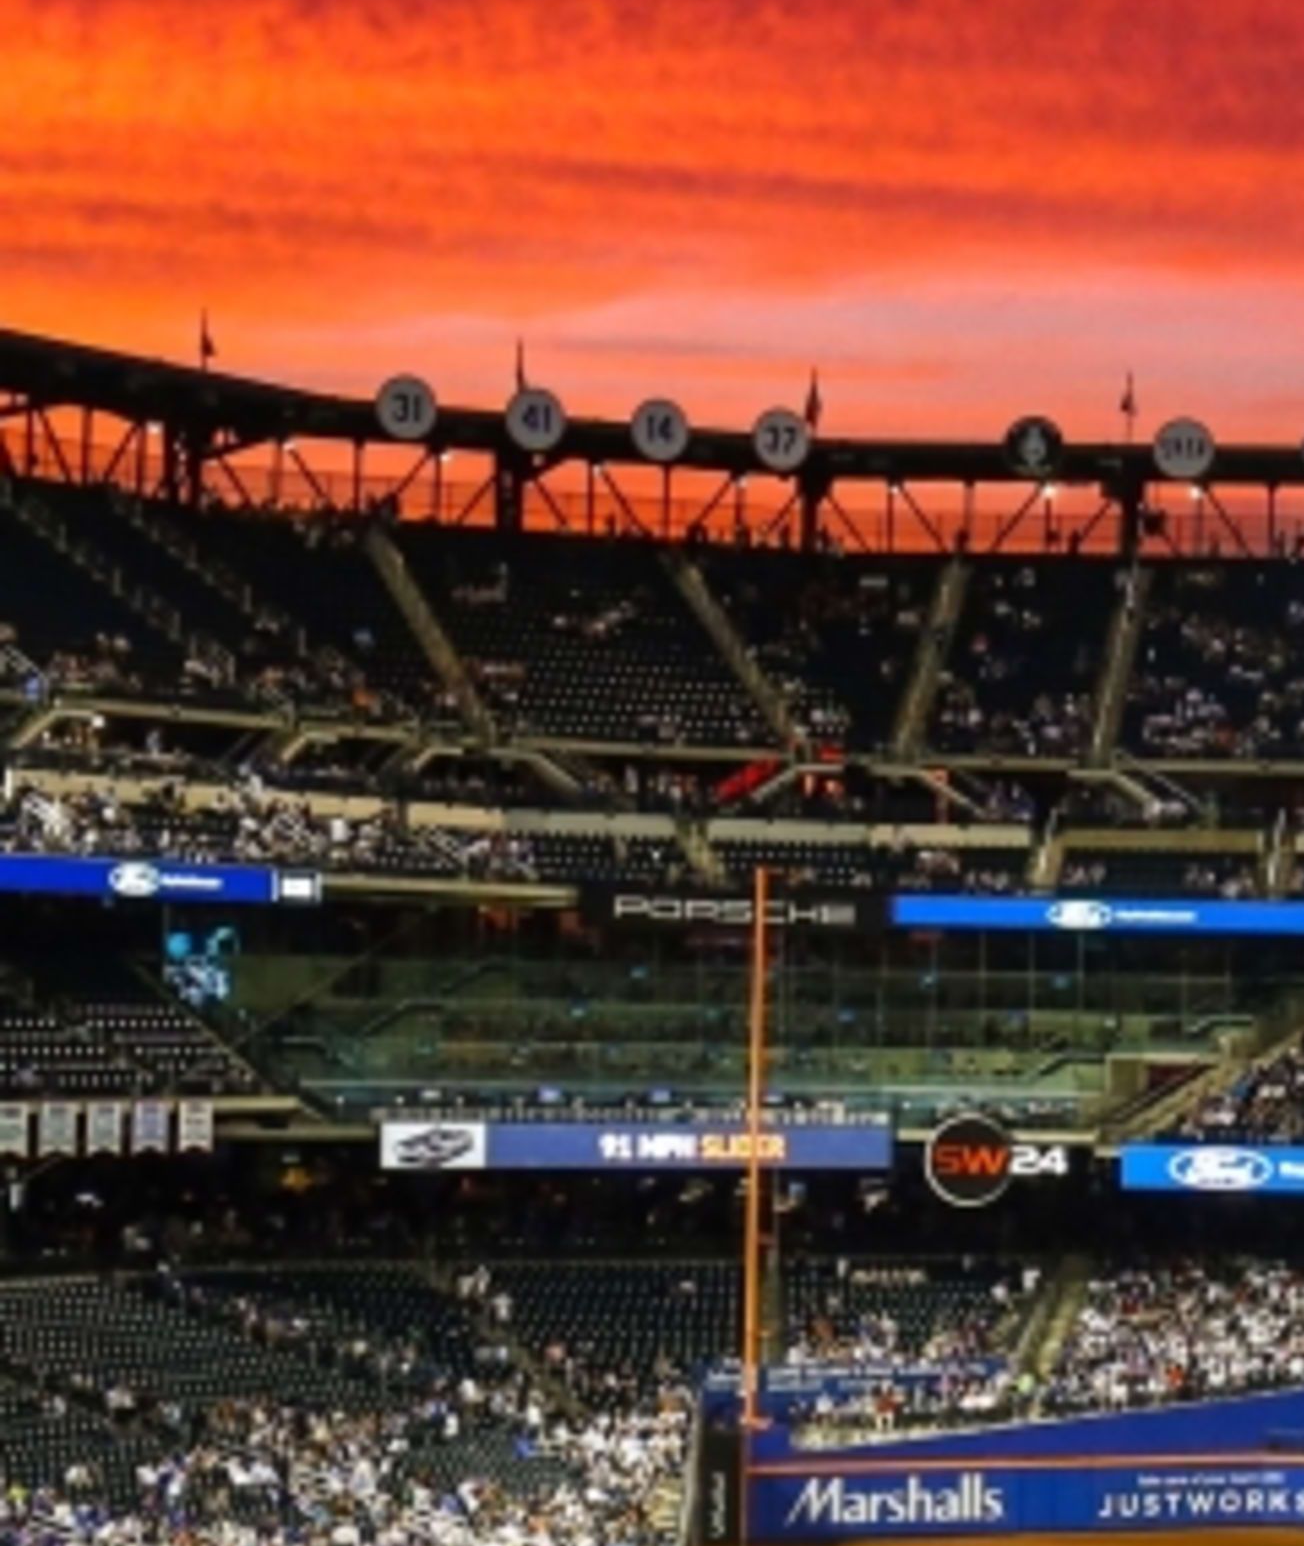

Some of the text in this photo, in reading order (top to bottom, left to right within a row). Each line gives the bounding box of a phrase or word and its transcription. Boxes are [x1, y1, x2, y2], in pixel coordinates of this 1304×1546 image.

[391, 393, 422, 422] 31
[520, 403, 553, 434] 41
[645, 414, 673, 443] 14
[763, 424, 798, 454] 37
[612, 893, 856, 926] PORSCHE
[784, 1471, 1004, 1526] Marshalls
